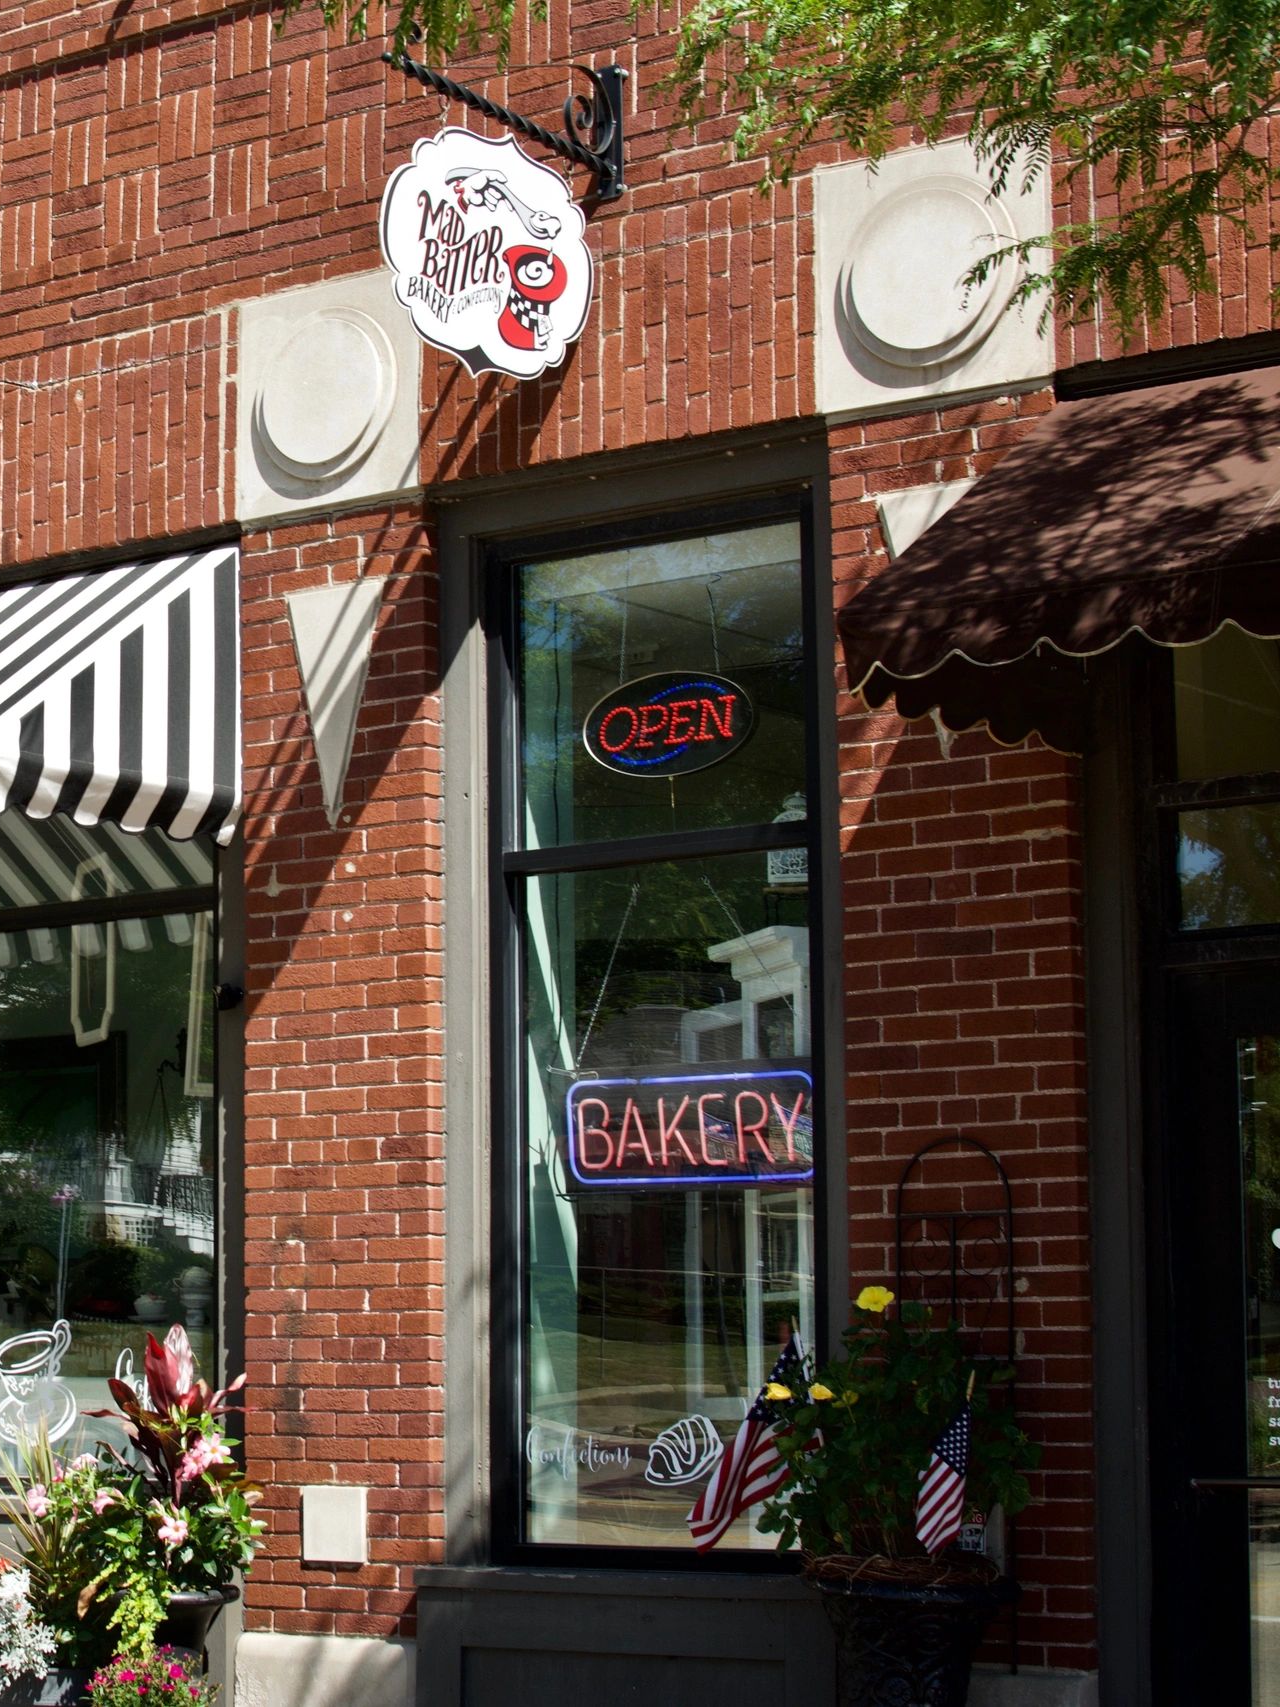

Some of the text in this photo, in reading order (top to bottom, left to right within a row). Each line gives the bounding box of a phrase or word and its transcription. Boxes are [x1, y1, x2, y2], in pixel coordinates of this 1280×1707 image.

[407, 275, 454, 323] BAKERY
[599, 694, 735, 753] OPEN
[577, 1090, 806, 1170] BAKERY
[525, 1425, 632, 1481] Confections
